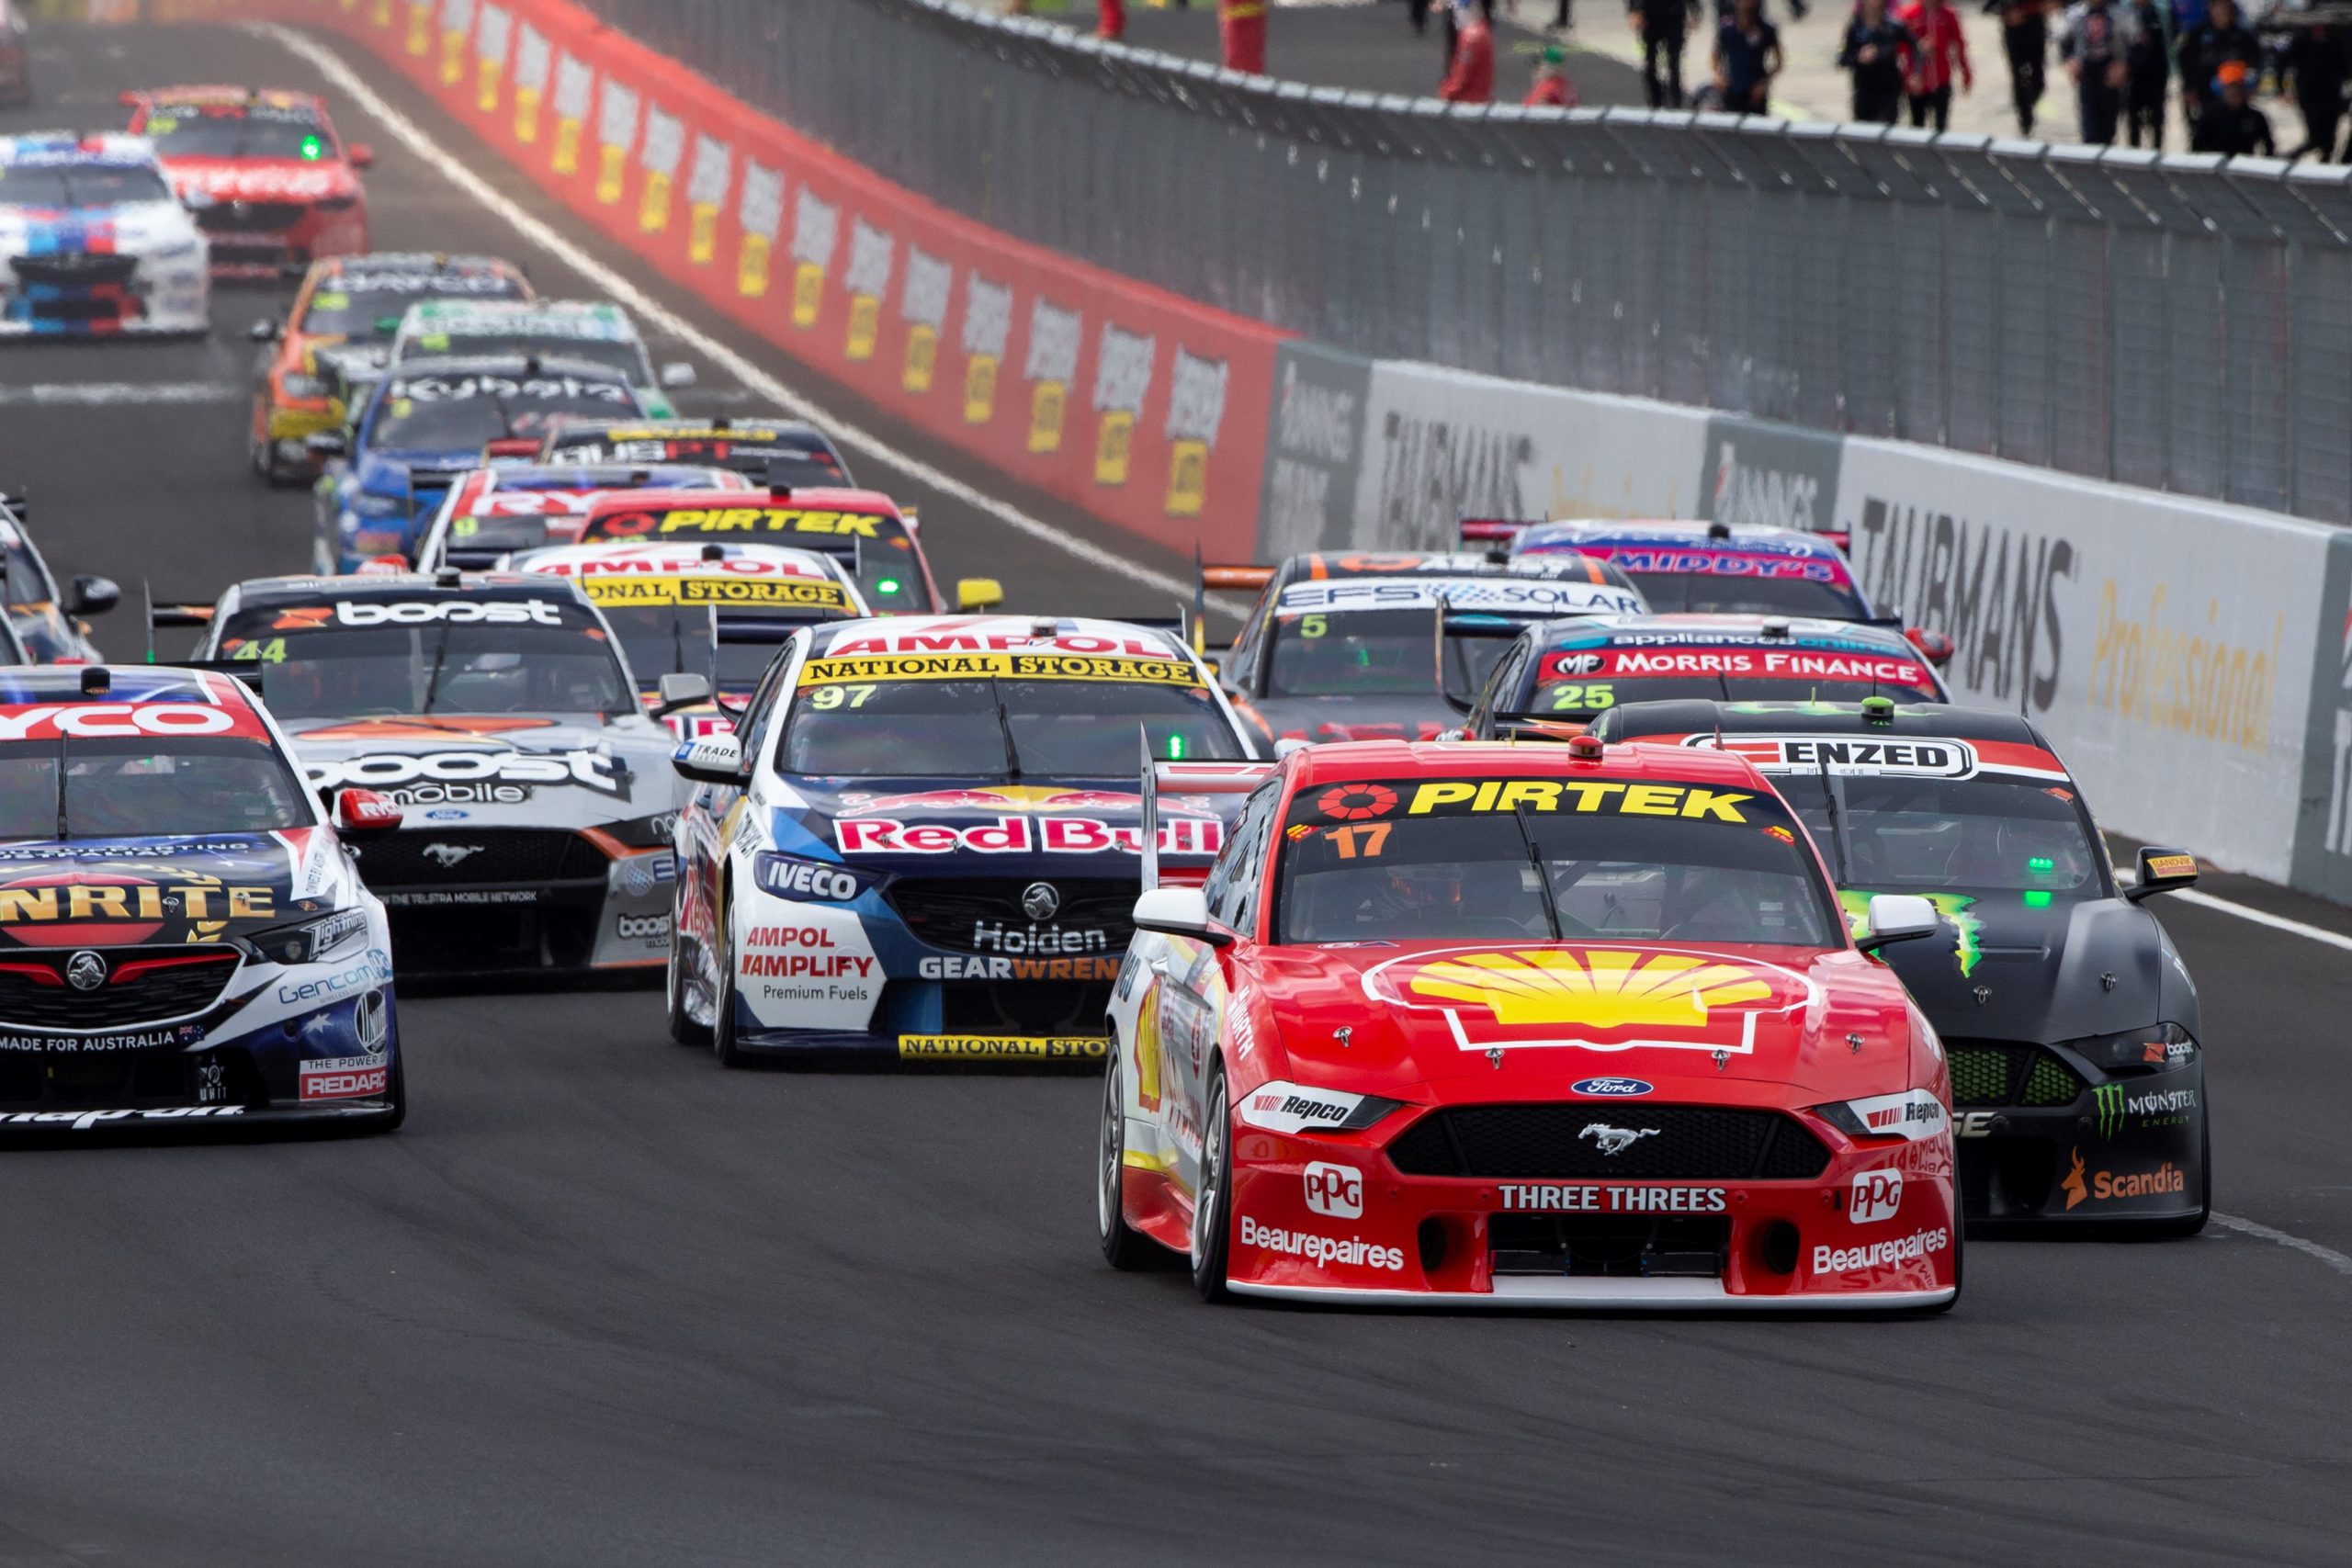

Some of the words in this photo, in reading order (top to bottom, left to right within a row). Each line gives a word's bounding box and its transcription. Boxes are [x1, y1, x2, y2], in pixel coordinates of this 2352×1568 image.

[660, 508, 884, 537] PIRTEK
[1614, 552, 1833, 582] MIDDY'S
[687, 581, 839, 604] STORAGE
[1279, 583, 1420, 608] EFS
[1504, 586, 1643, 614] SOLAR
[336, 599, 562, 626] boost
[1300, 614, 1328, 638] 5
[232, 638, 288, 663] 44
[829, 635, 1173, 659] AMPOL
[809, 657, 1000, 680] NATIONAL
[1019, 656, 1192, 682] STORAGE
[1615, 652, 1752, 672] MORRIS
[1765, 653, 1918, 682] FINANCE
[2088, 576, 2286, 755] Professional
[811, 684, 876, 710] 97
[1553, 684, 1615, 710] 25
[695, 744, 738, 759] TRADE
[1785, 742, 1949, 768] ENZED
[1408, 781, 1756, 824] PIRTEK
[832, 816, 1033, 854] Red
[1037, 817, 1225, 855] Bull
[1324, 822, 1394, 860] 17
[2152, 857, 2192, 869] SANDVIK
[768, 861, 857, 900] IVECO
[411, 892, 454, 906] TELSTRA
[455, 891, 489, 904] MOBILE
[491, 890, 537, 903] NETWORK
[618, 914, 670, 938] boos
[747, 926, 835, 948] AMPOL
[973, 920, 1107, 954] Holden
[744, 953, 874, 978] AMPLIFY
[919, 956, 1120, 981] GEARWREN
[278, 964, 374, 1005] Gencom
[763, 984, 824, 1000] Premium
[829, 985, 868, 1000] Fuels
[0, 1036, 41, 1051] MADE
[47, 1038, 77, 1052] FOR
[83, 1031, 175, 1052] AUSTRALIA
[905, 1038, 1039, 1055] NATIONAL
[1052, 1039, 1110, 1056] STO
[2165, 1040, 2194, 1055] boost
[308, 1059, 332, 1070] THE
[339, 1055, 378, 1068] POWER
[307, 1070, 387, 1096] REDARC
[1587, 1077, 1637, 1094] Ford
[1280, 1095, 1349, 1122] Repco
[1905, 1101, 1939, 1123] Repco
[2142, 1115, 2190, 1128] ENERGY
[1306, 1168, 1360, 1211] PPG
[2094, 1160, 2184, 1200] Scandia
[1498, 1185, 1600, 1210] THREE
[1607, 1187, 1727, 1212] THREES
[1852, 1174, 1901, 1218] PPG
[1241, 1215, 1405, 1271] Beaurepaires
[1814, 1226, 1948, 1275] Beaurepaires
